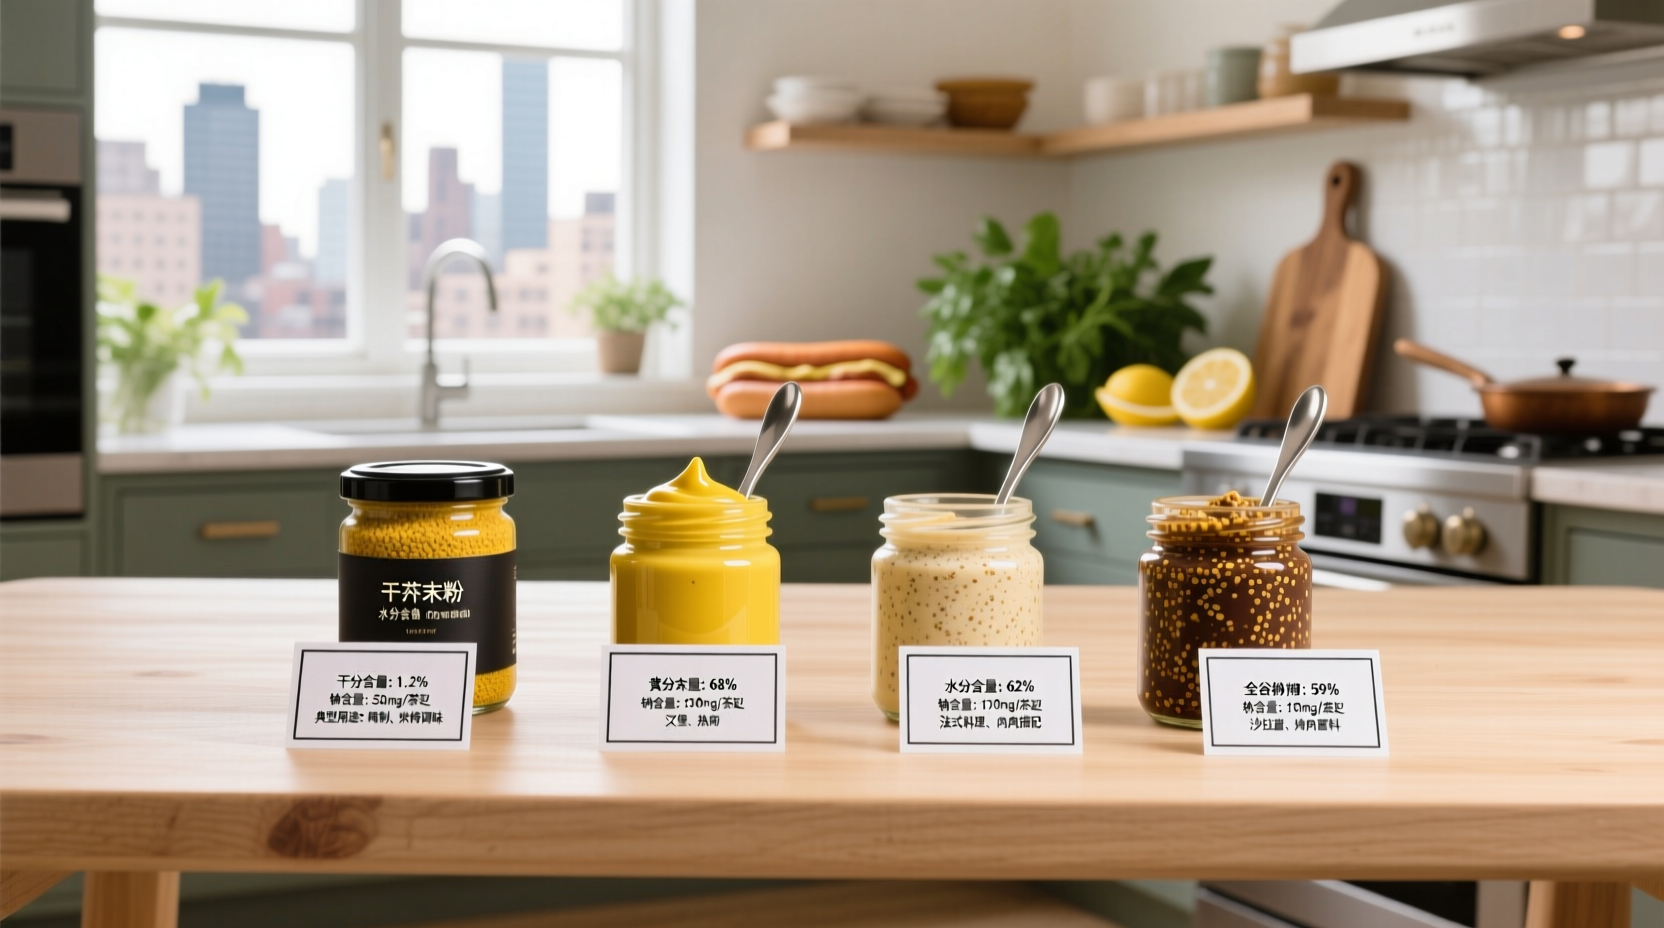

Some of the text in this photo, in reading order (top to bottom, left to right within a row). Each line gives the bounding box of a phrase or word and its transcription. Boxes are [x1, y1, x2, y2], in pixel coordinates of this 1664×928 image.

[397, 675, 429, 689] 1.2%
[709, 677, 738, 691] 68%
[1006, 679, 1035, 693] 62%
[1310, 682, 1340, 696] 59%
